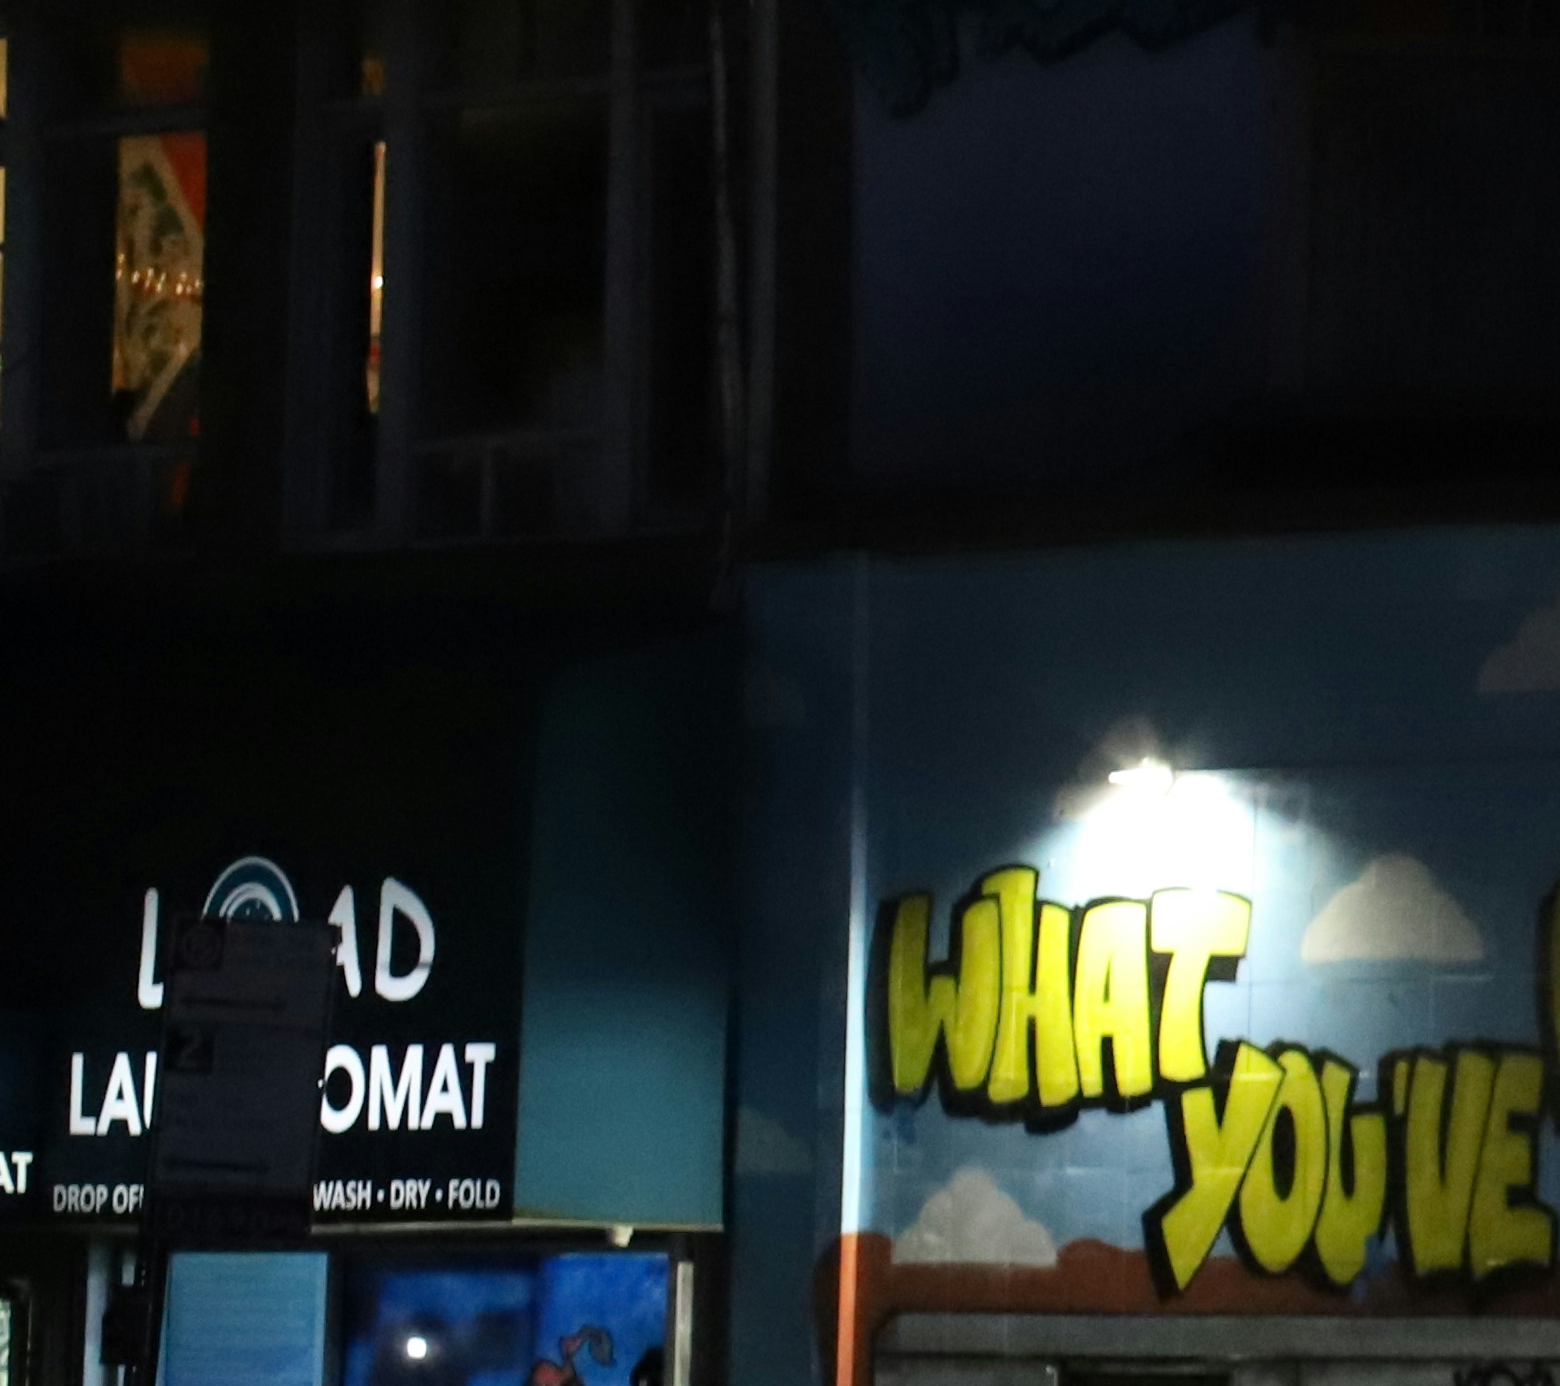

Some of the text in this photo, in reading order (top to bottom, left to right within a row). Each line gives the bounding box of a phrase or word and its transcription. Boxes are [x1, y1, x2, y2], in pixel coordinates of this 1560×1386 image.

[873, 864, 1252, 1131] WHAT
[53, 1183, 111, 1214] DROP
[313, 1179, 372, 1212] WASH
[388, 1179, 428, 1211] DRY
[447, 1178, 501, 1212] FOLD
